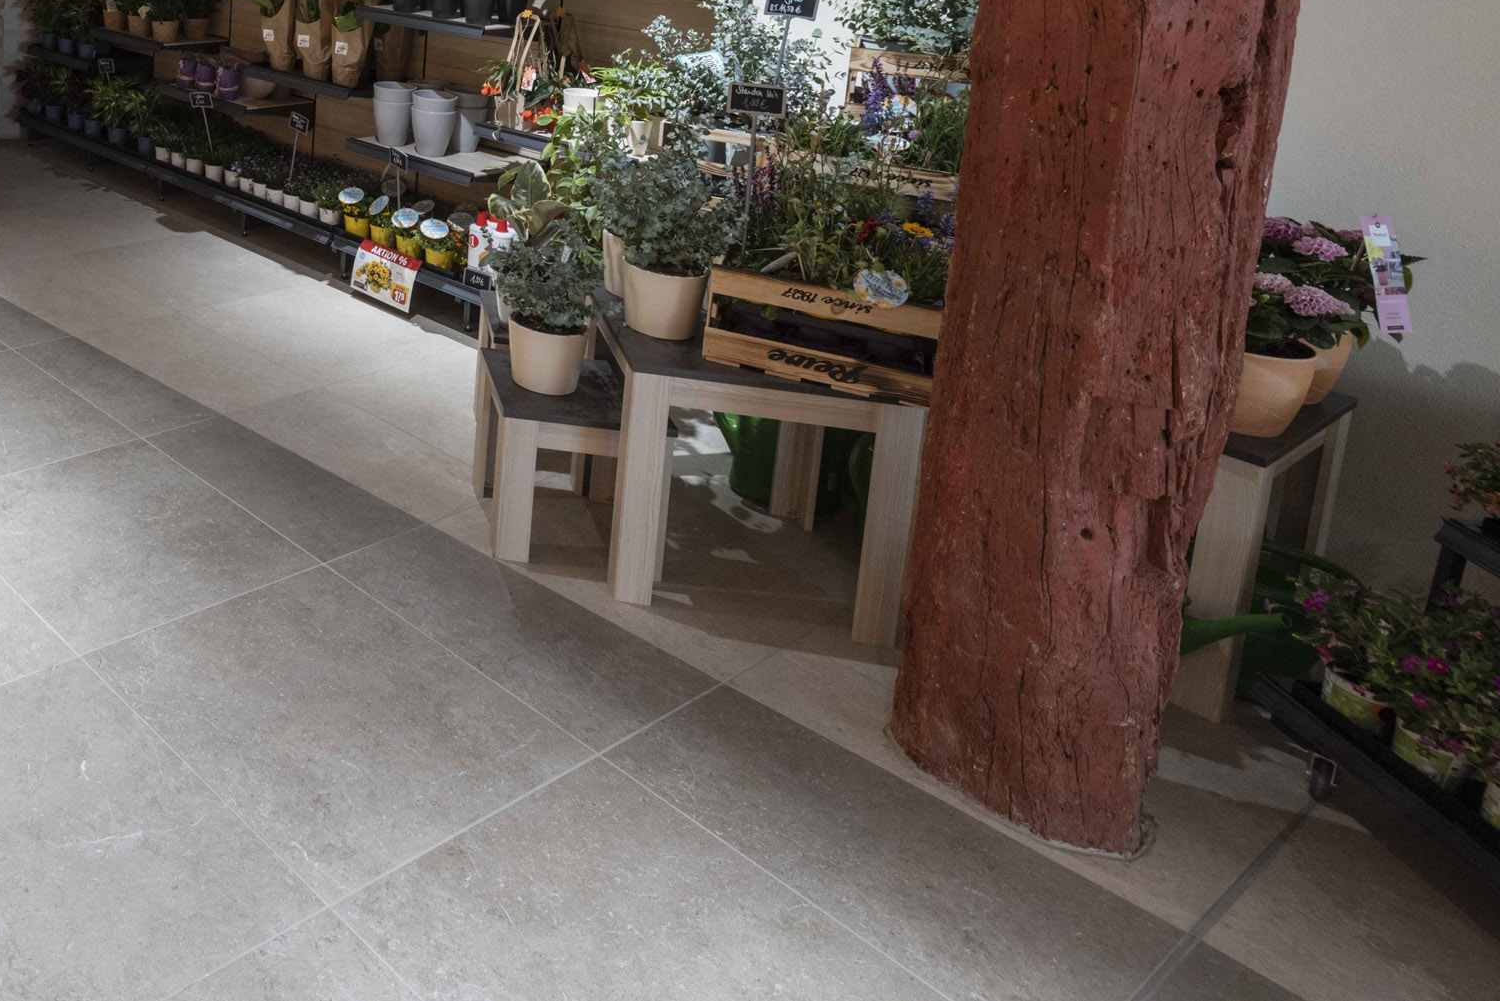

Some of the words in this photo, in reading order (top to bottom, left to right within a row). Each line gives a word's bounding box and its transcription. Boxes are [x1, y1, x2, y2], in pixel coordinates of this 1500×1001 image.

[469, 235, 475, 246] 1
[370, 245, 399, 262] AKTION
[398, 255, 408, 266] %
[822, 296, 874, 315] since
[767, 349, 868, 384] Rewe
